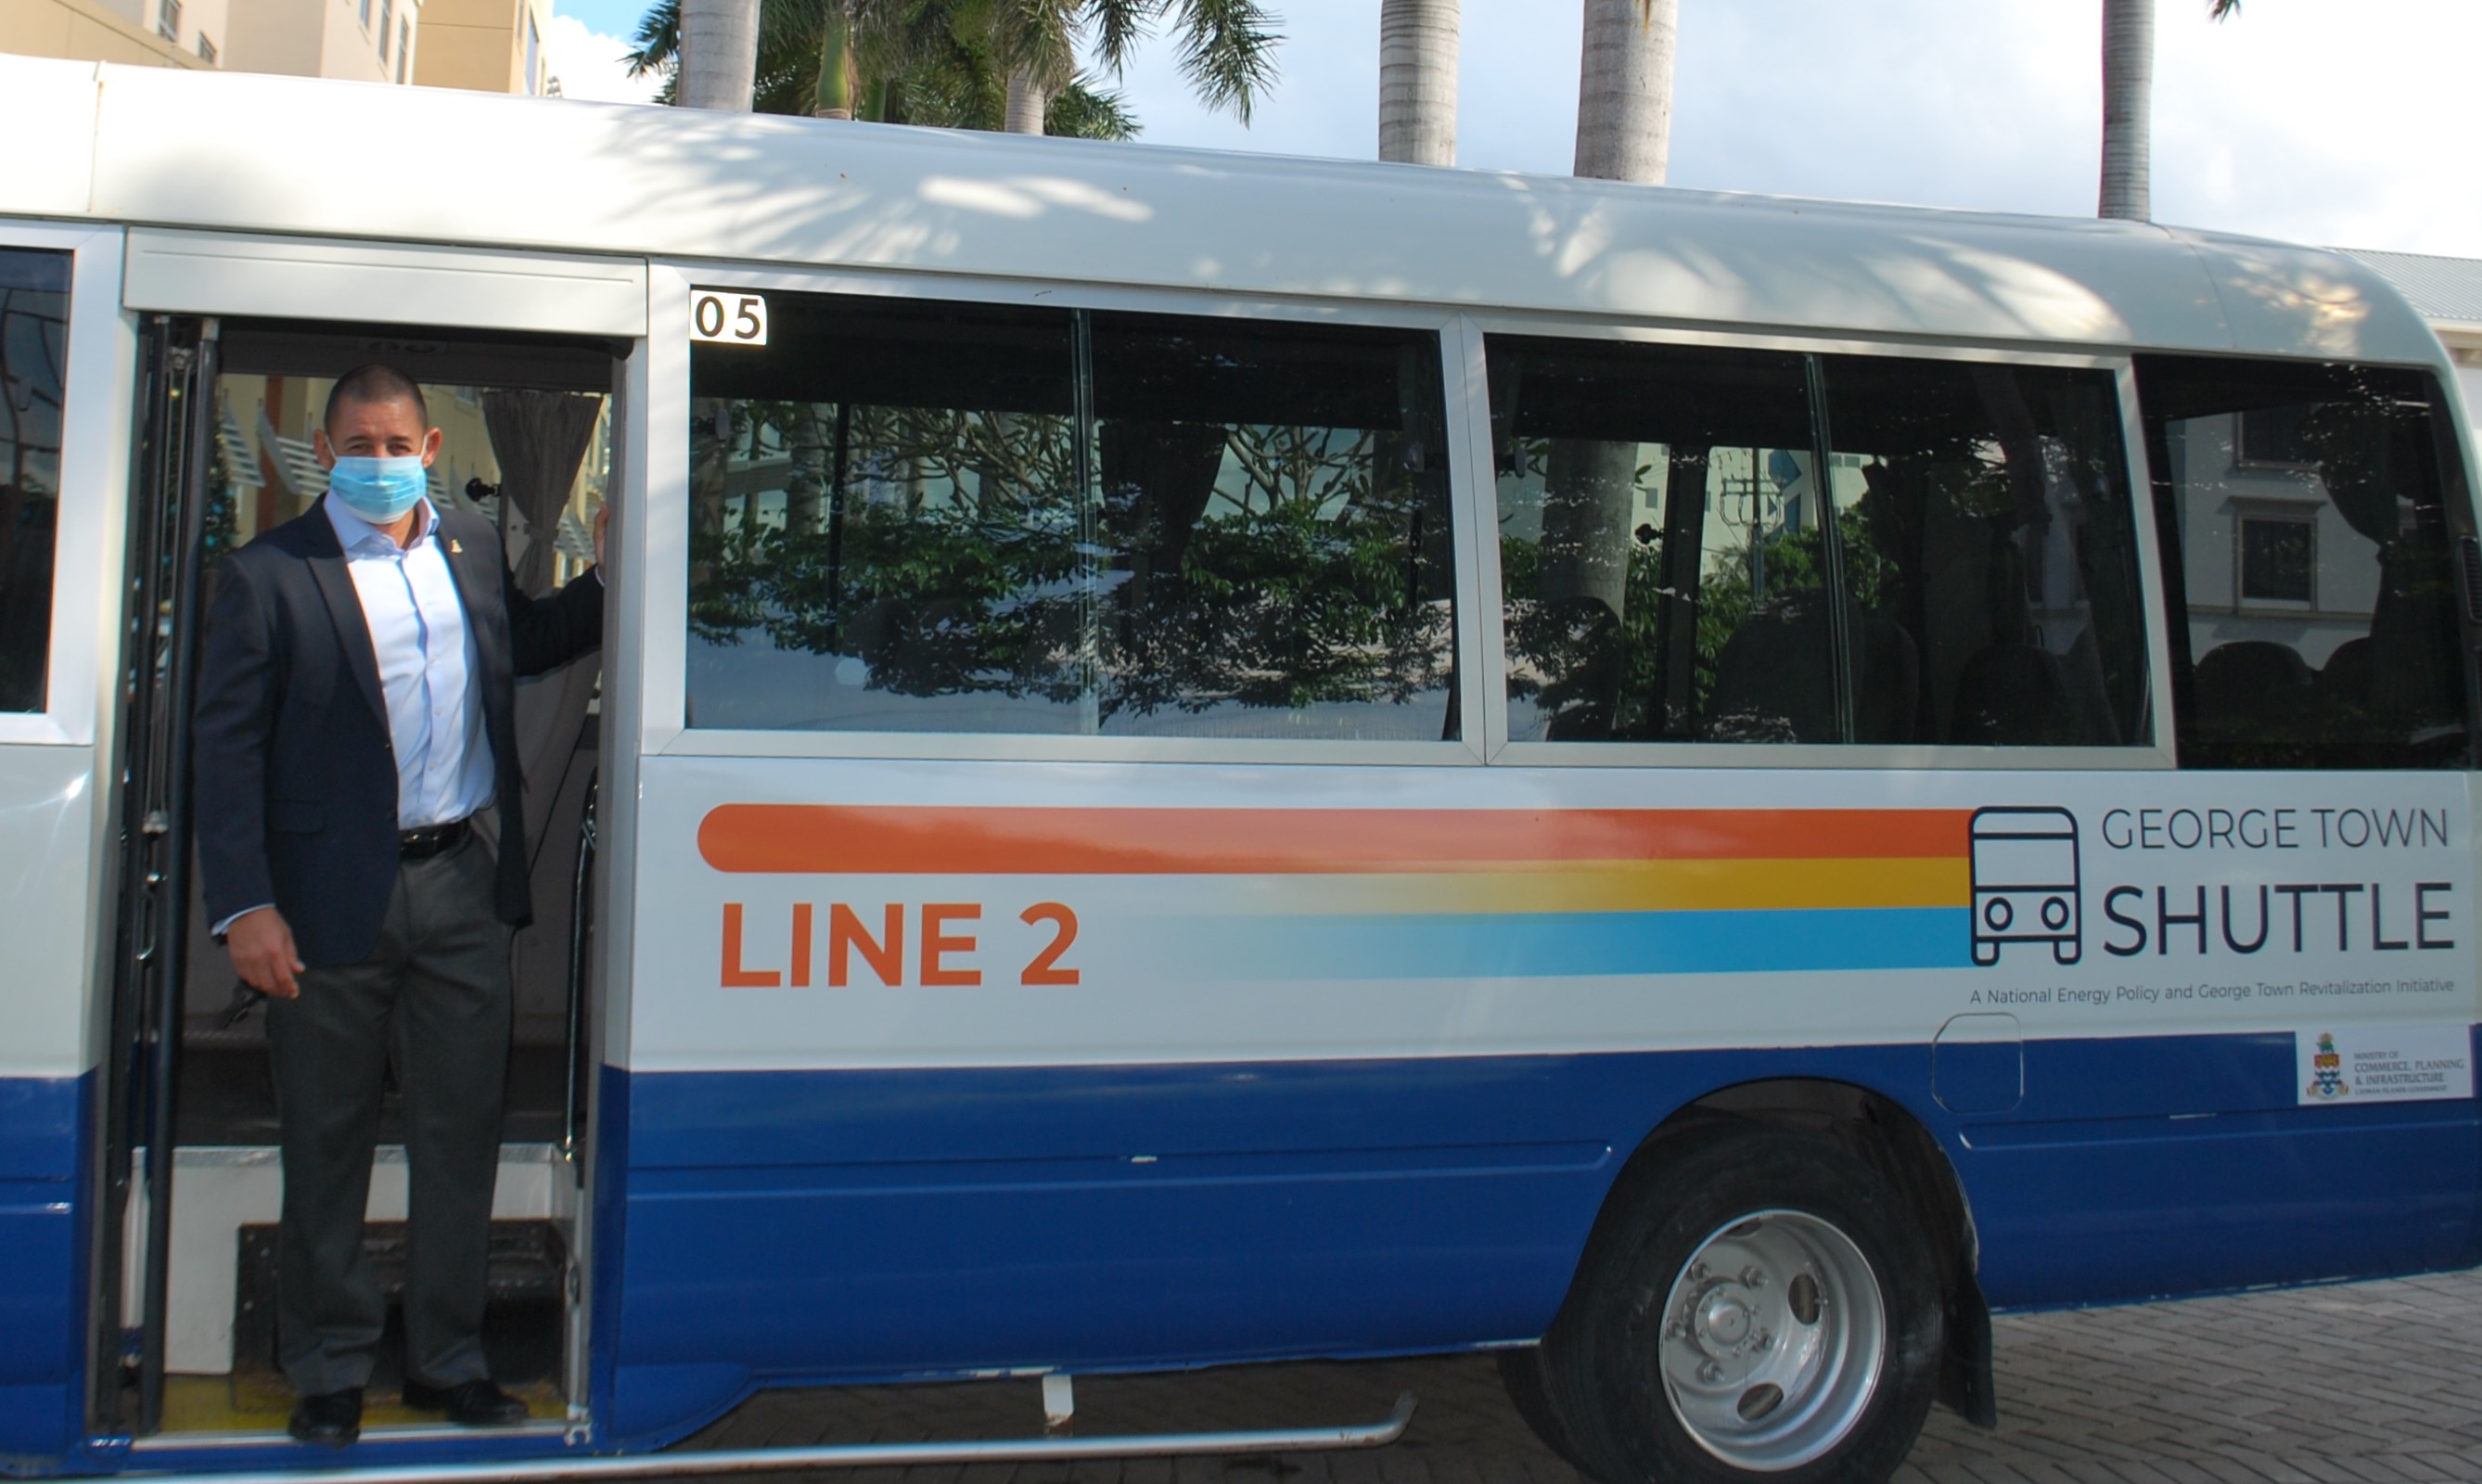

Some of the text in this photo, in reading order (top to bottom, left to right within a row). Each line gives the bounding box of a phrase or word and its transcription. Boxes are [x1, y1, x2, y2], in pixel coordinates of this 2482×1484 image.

[696, 296, 761, 339] 05
[2102, 809, 2449, 849] GEORGE TOWN
[2103, 882, 2455, 957] SHUTTLE
[721, 902, 1080, 987] LINE 2
[1970, 979, 2454, 1004] A National Energy Policy and George Town Revitalization Initiative
[2366, 1073, 2444, 1084] INFRASTRUCTURE
[2415, 1059, 2464, 1070] PLANNING
